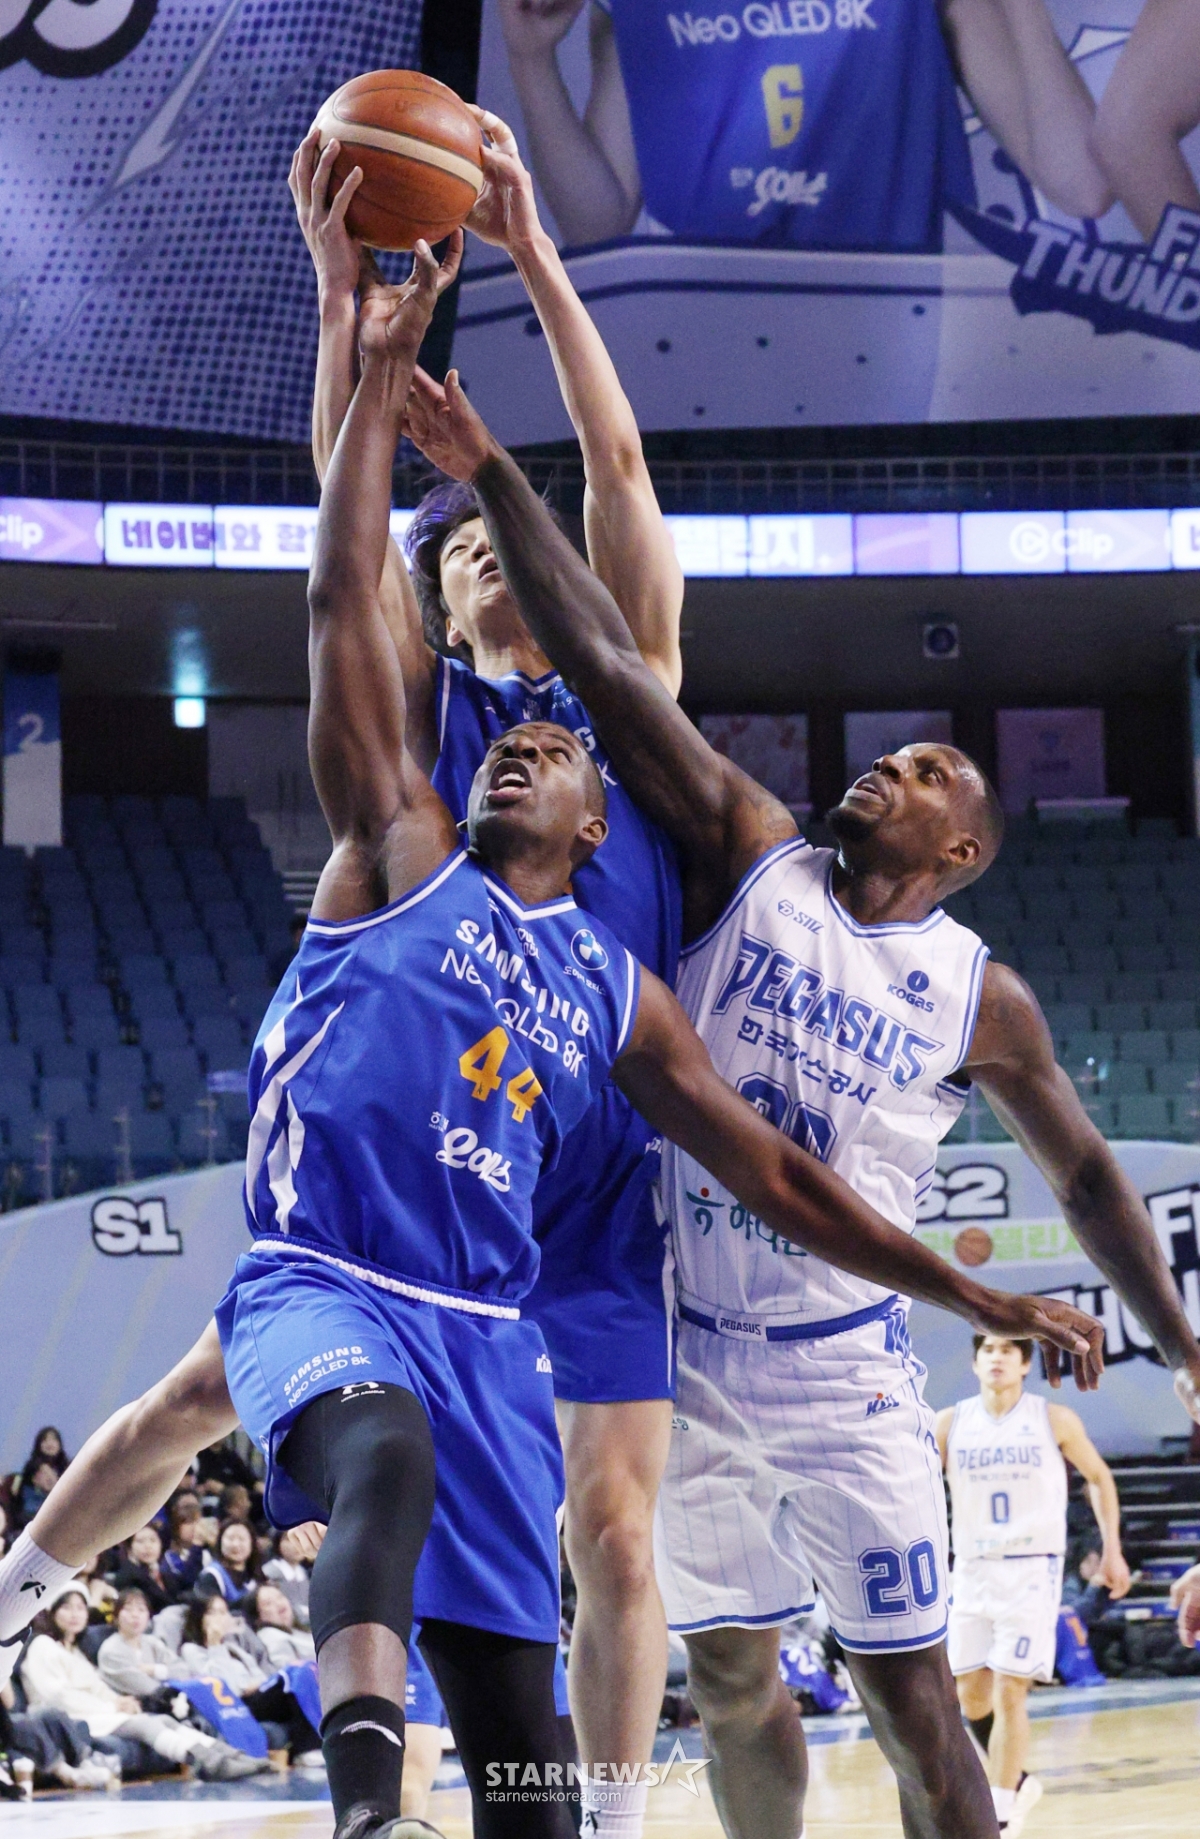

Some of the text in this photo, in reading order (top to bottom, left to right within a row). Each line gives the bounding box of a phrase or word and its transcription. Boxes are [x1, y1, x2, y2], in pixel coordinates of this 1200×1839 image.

[667, 0, 877, 47] Neo QLED 8K
[761, 63, 804, 150] 6
[711, 930, 946, 1092] PEGASUS
[459, 1026, 543, 1123] 44
[562, 1040, 587, 1078] 8K
[737, 1015, 877, 1106] 한국가스공사
[90, 1195, 183, 1257] S1
[720, 1317, 762, 1336] PEGASUS
[283, 1345, 363, 1396] SAMSUNG
[288, 1355, 372, 1408] Neo QLED 8K
[957, 1445, 1042, 1473] PEGASUS
[991, 1491, 1009, 1524] 0
[858, 1535, 939, 1618] 20
[1014, 1636, 1031, 1660] 0
